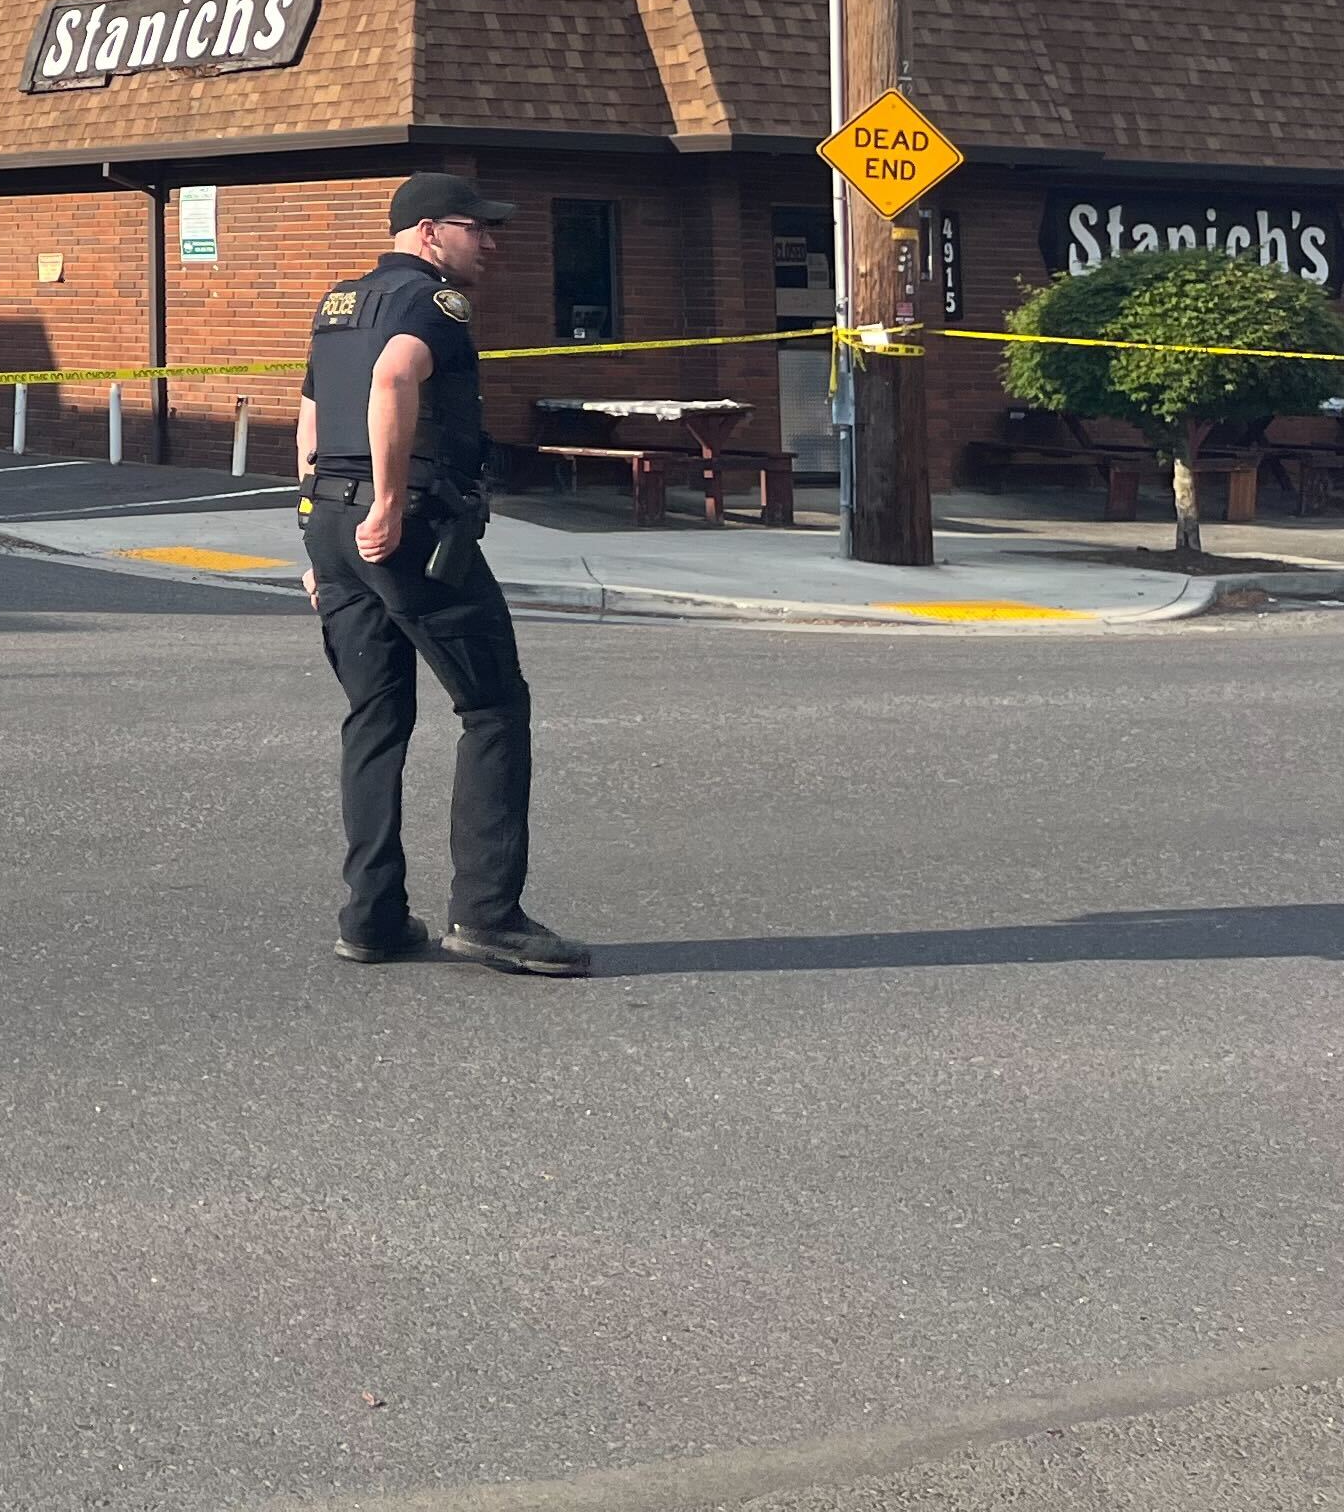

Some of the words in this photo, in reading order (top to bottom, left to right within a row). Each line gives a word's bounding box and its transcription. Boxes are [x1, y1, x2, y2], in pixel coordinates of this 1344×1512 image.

[855, 127, 929, 151] DEAD
[865, 158, 916, 180] END
[942, 218, 956, 313] 4915
[321, 300, 354, 315] POLICE
